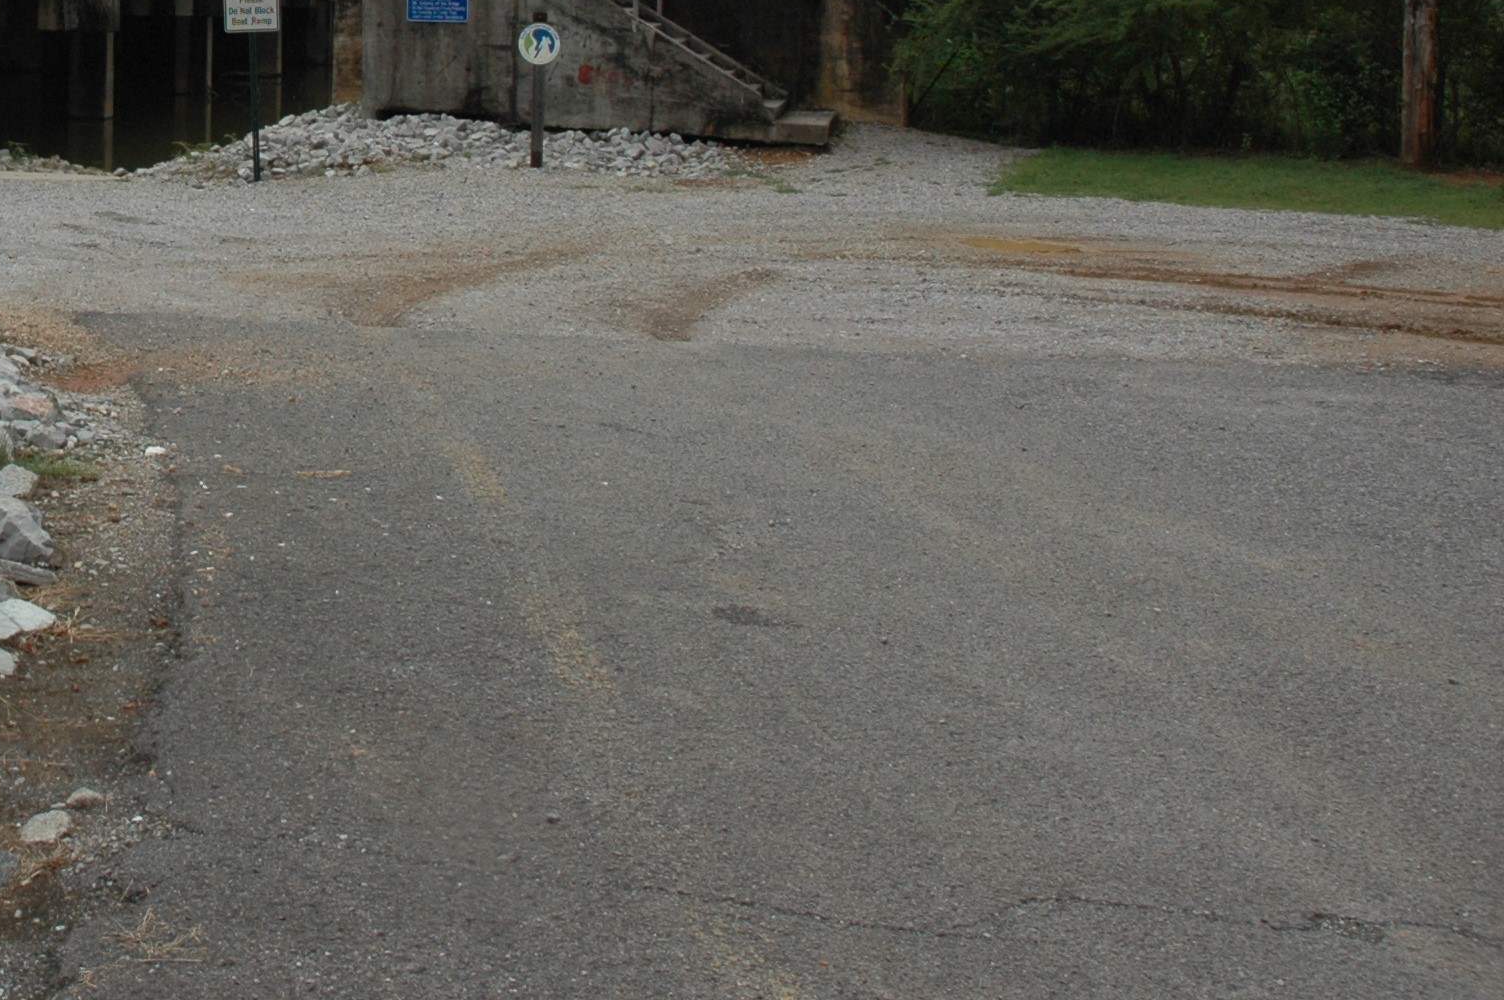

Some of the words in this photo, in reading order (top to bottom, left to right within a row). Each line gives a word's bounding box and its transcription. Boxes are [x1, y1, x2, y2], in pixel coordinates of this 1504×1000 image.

[228, 7, 238, 15] Do
[239, 7, 252, 15] Not
[254, 6, 275, 15] Block
[231, 17, 248, 26] Boat
[251, 17, 272, 27] Ramp
